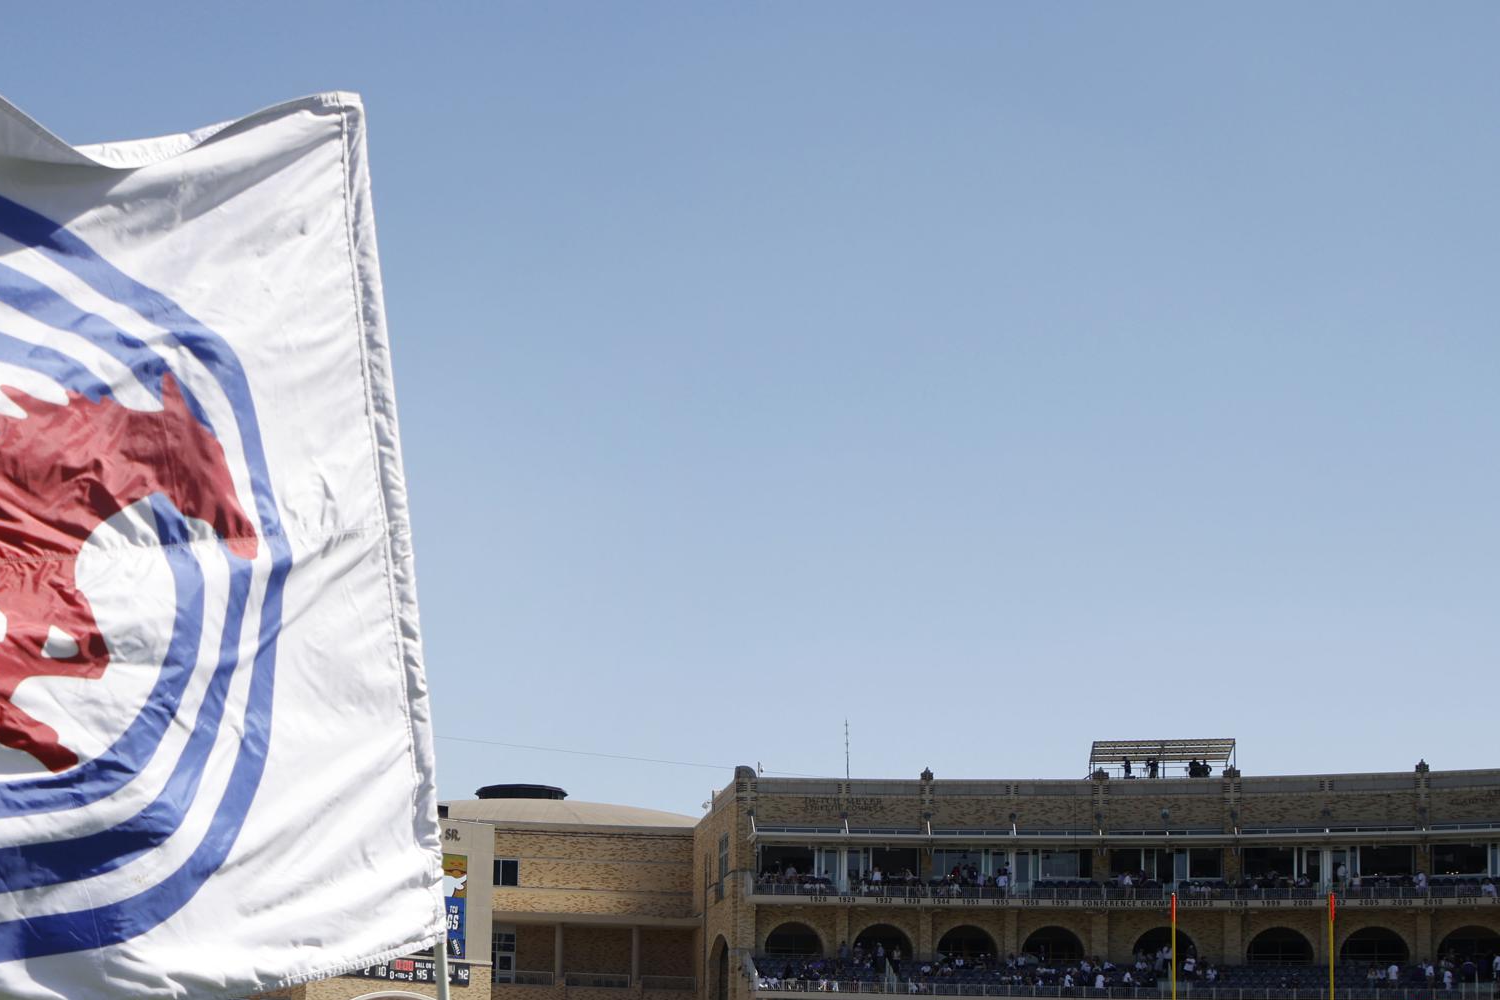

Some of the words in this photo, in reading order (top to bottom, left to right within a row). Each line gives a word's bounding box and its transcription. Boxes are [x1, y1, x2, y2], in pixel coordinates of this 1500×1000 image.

[445, 828, 461, 842] SR.
[1082, 900, 1137, 908] CONFERENCE
[1140, 900, 1214, 908] CHAMPNSHIPS
[416, 969, 428, 980] 45
[458, 969, 469, 980] 42
